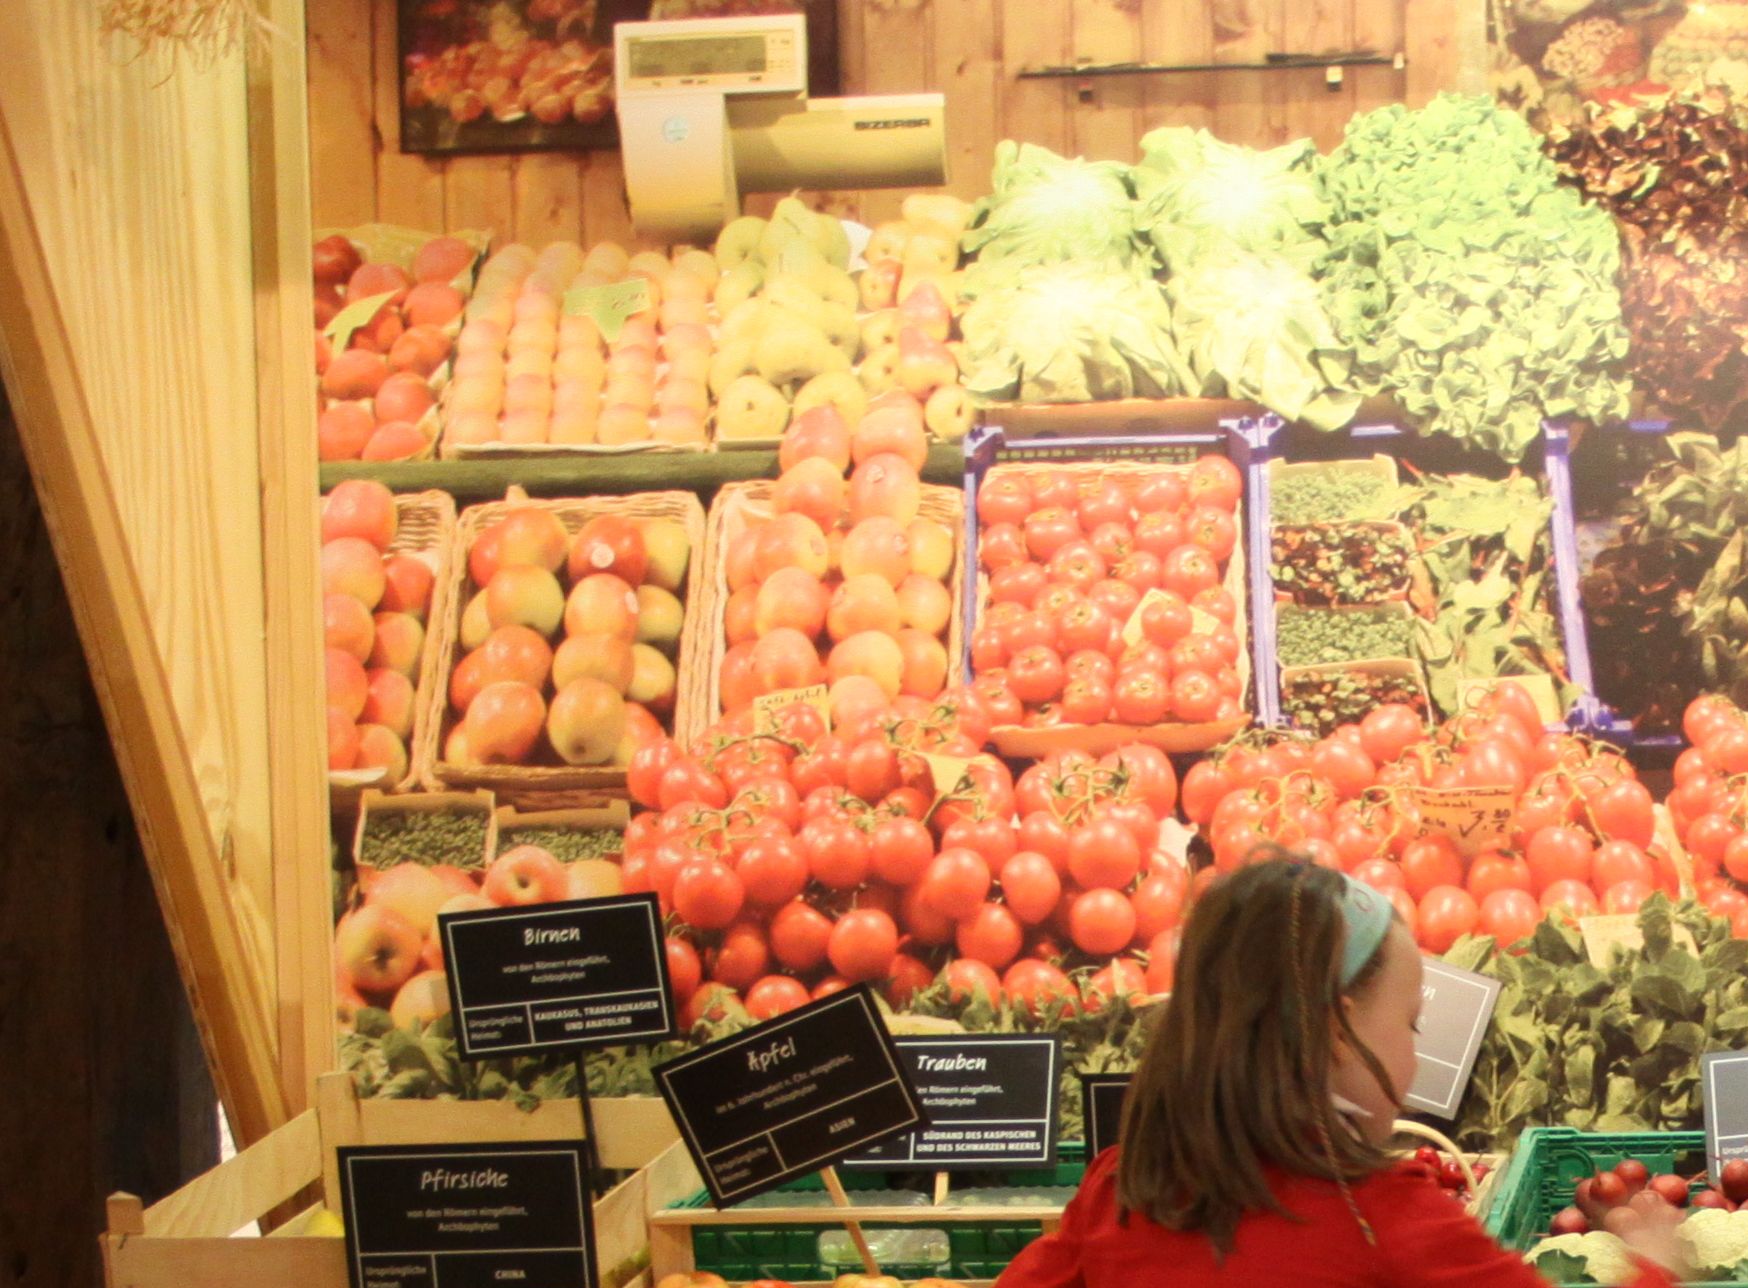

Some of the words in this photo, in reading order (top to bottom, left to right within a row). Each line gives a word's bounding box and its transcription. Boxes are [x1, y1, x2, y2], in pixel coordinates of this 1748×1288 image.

[524, 927, 581, 946] Birnen
[565, 1021, 583, 1031] UND
[585, 1016, 631, 1029] ANATOLIEN
[747, 1036, 796, 1072] Äpfel
[917, 1053, 987, 1071] Trauben
[829, 1116, 856, 1134] ASIEN
[923, 1130, 963, 1140] SÜDRAND
[965, 1131, 982, 1140] DES
[983, 1130, 1036, 1139] KASPISCHEN
[916, 1143, 934, 1152] UND
[936, 1143, 953, 1152] DES
[955, 1142, 1006, 1152] SCHWARZEN
[1007, 1142, 1041, 1151] MEERES
[421, 1168, 509, 1191] Pfirsiche
[494, 1269, 526, 1279] CHINA
